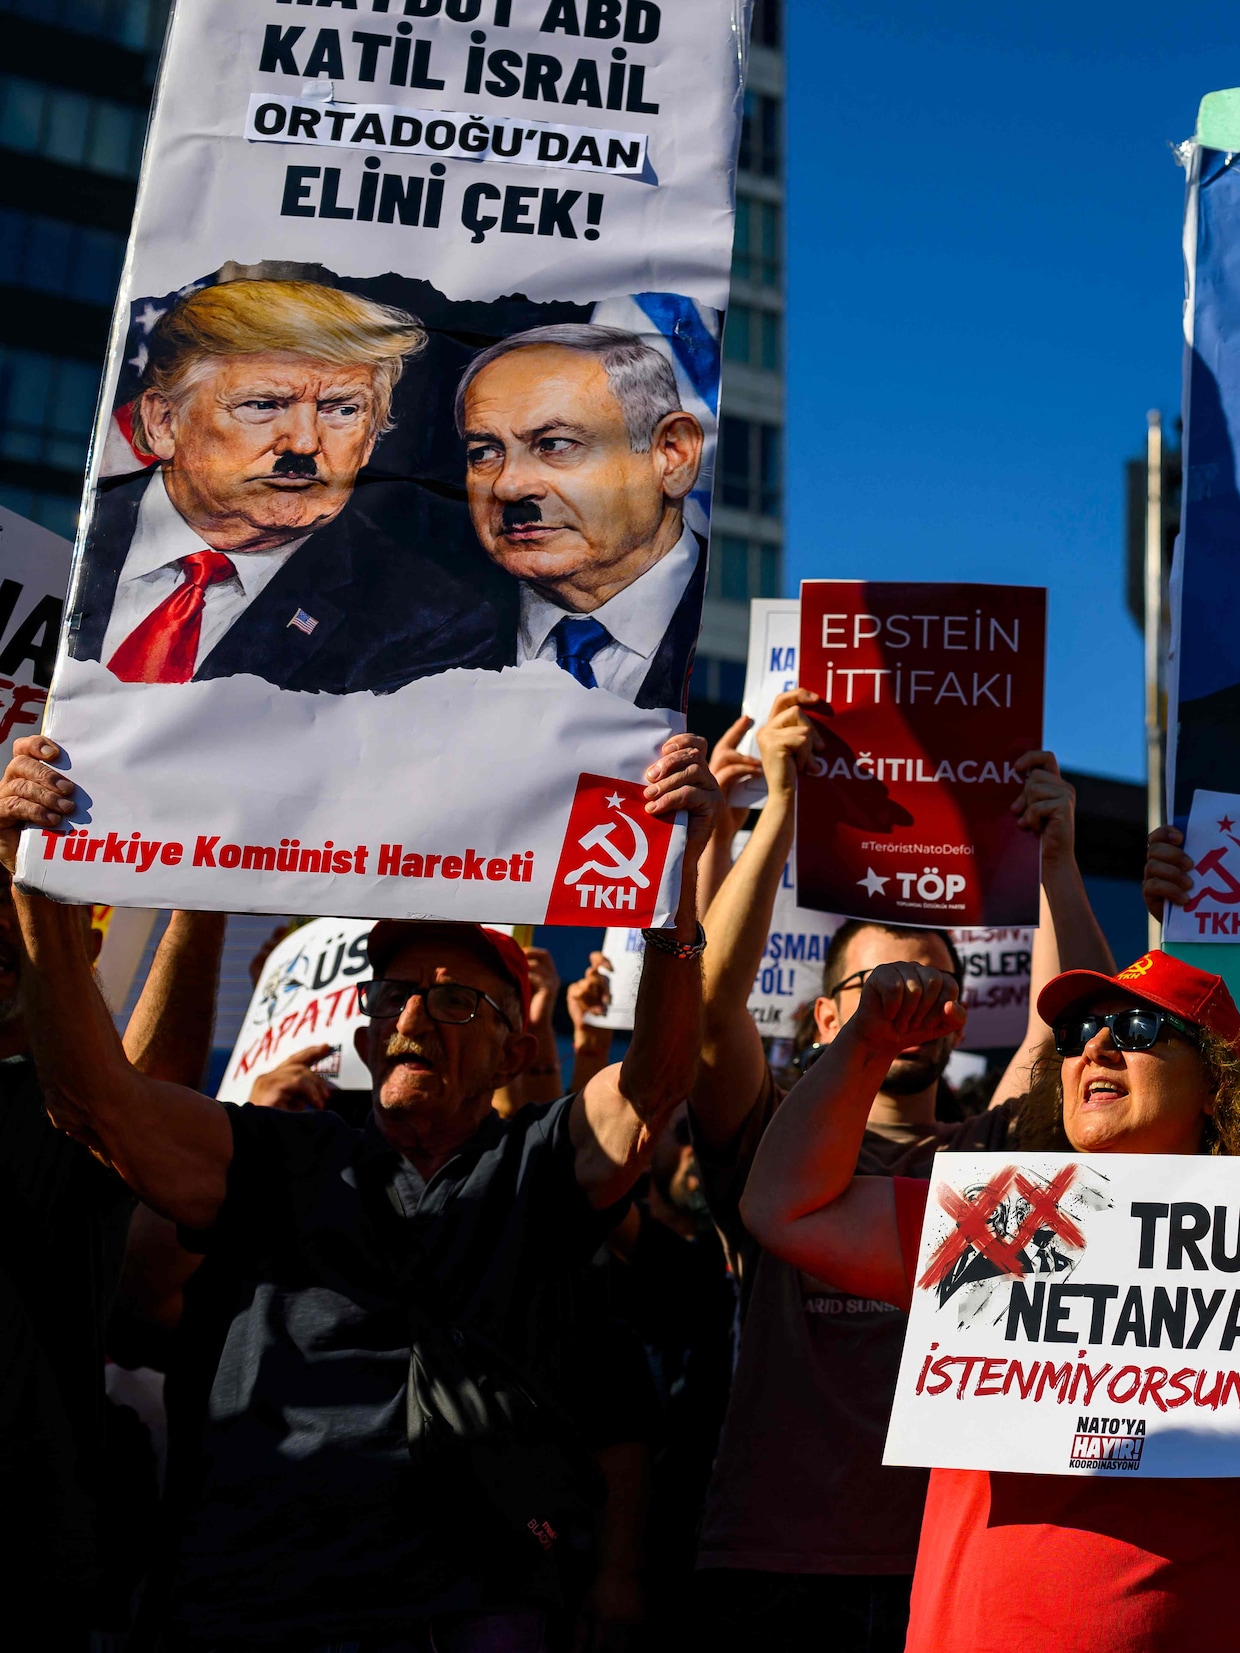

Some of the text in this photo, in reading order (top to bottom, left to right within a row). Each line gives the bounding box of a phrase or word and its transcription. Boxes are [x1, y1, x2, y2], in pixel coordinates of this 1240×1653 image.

[539, 0, 661, 44] ABD
[258, 21, 660, 115] KATİL İSRAİL
[253, 103, 640, 169] ORTADOĞU'DAN
[280, 156, 604, 244] ELİNİ ÇEK!
[821, 609, 1019, 653] EPSTEİN
[825, 661, 1012, 708] İTTİFAKI
[42, 829, 534, 883] Türkiye Komünist Hareketi
[575, 884, 638, 911] TKH
[895, 866, 967, 902] TÖP
[962, 950, 1032, 977] SLER
[1072, 1436, 1142, 1460] HAYIR!
[1076, 1416, 1146, 1436] NATO'YA
